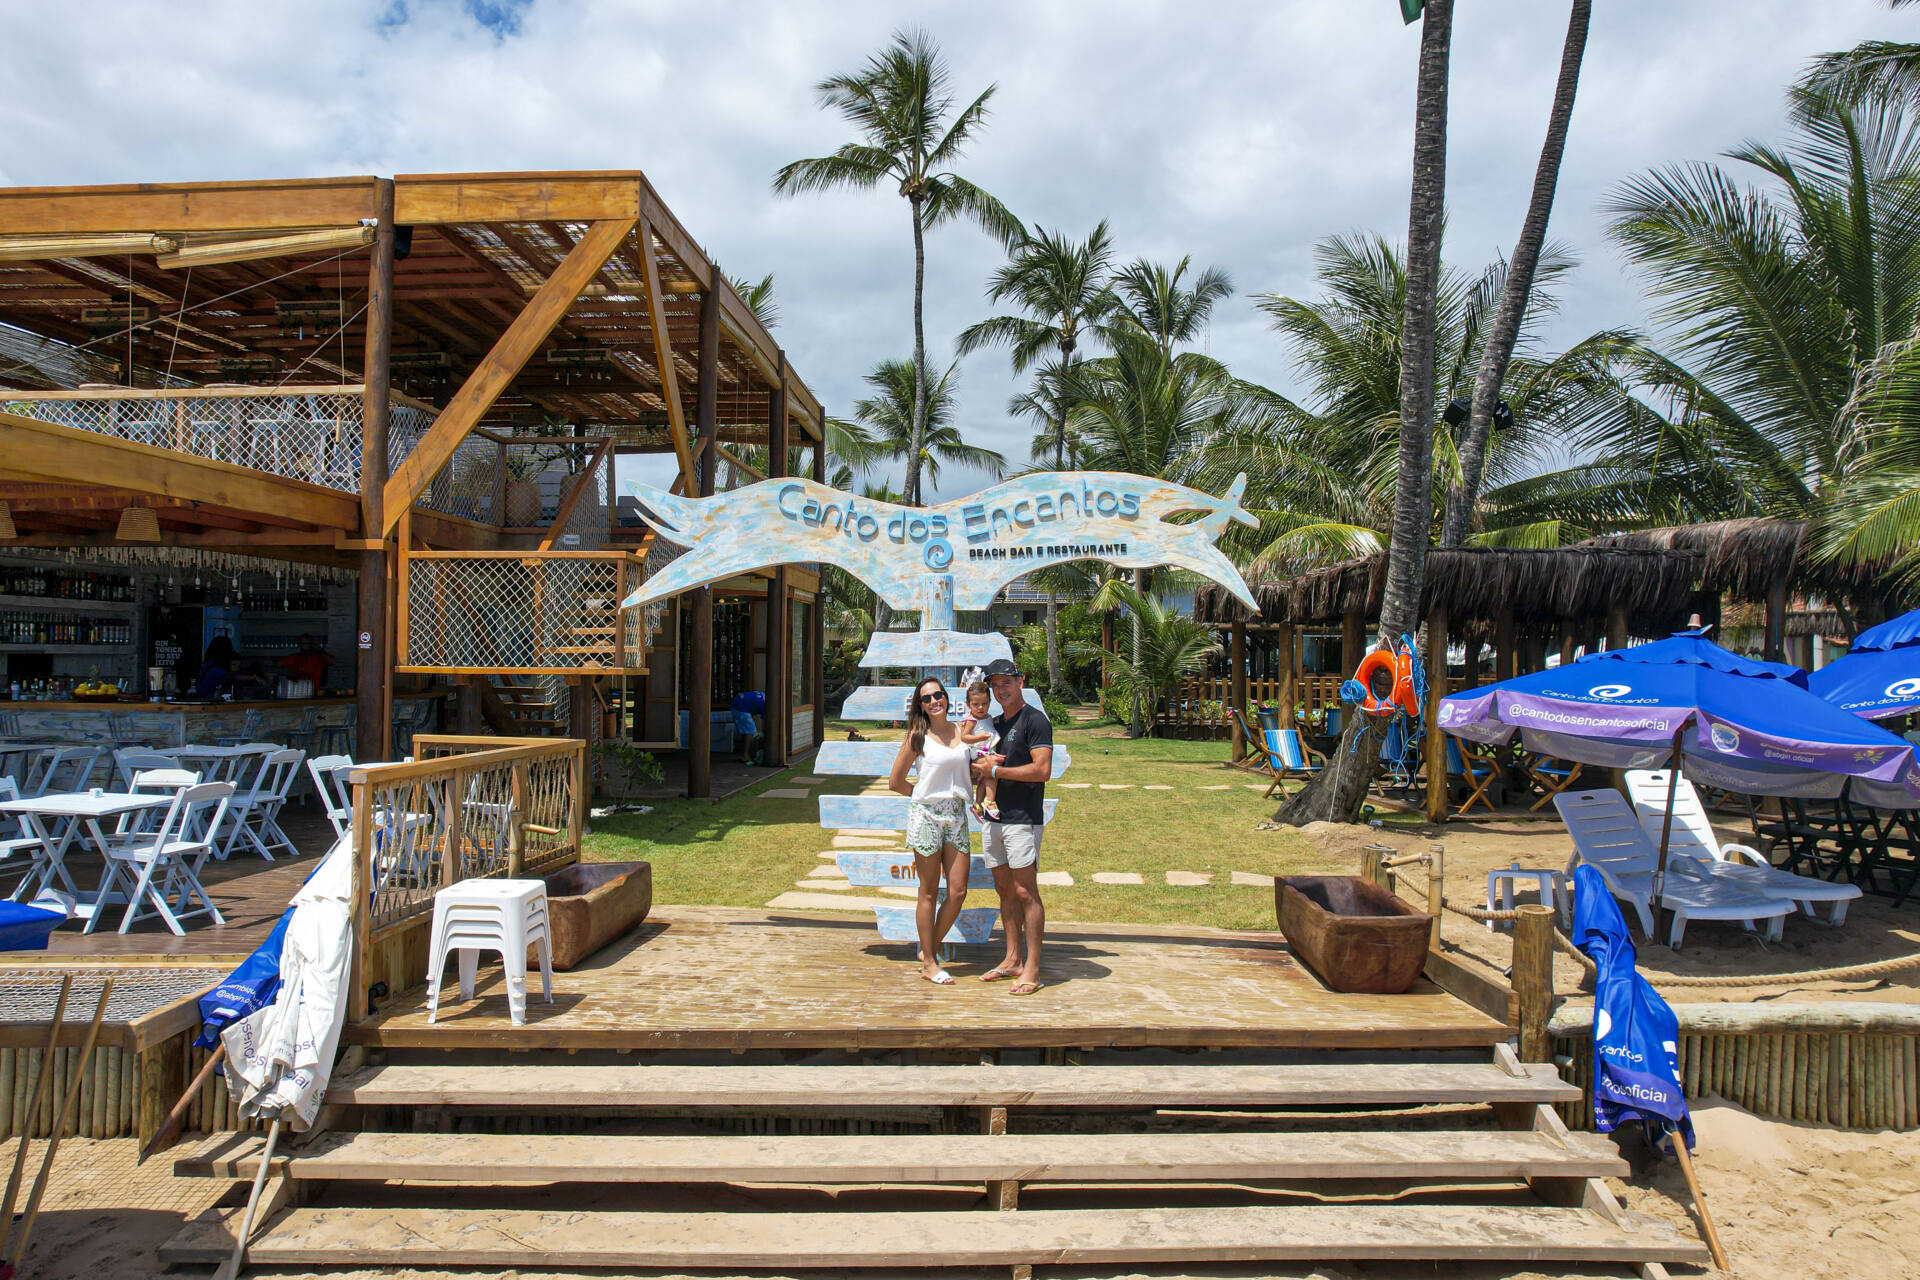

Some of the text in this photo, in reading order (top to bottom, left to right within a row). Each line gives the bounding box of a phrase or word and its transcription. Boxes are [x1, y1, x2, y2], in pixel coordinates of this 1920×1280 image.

[777, 478, 1141, 542] Canto dos Encantos
[969, 544, 1128, 560] BEACH BAR E RESTAURANTE
[1541, 689, 1576, 699] Canto
[1840, 701, 1876, 710] Canto
[1877, 697, 1900, 705] dos
[1508, 703, 1669, 731] @cantodosencantosoficial
